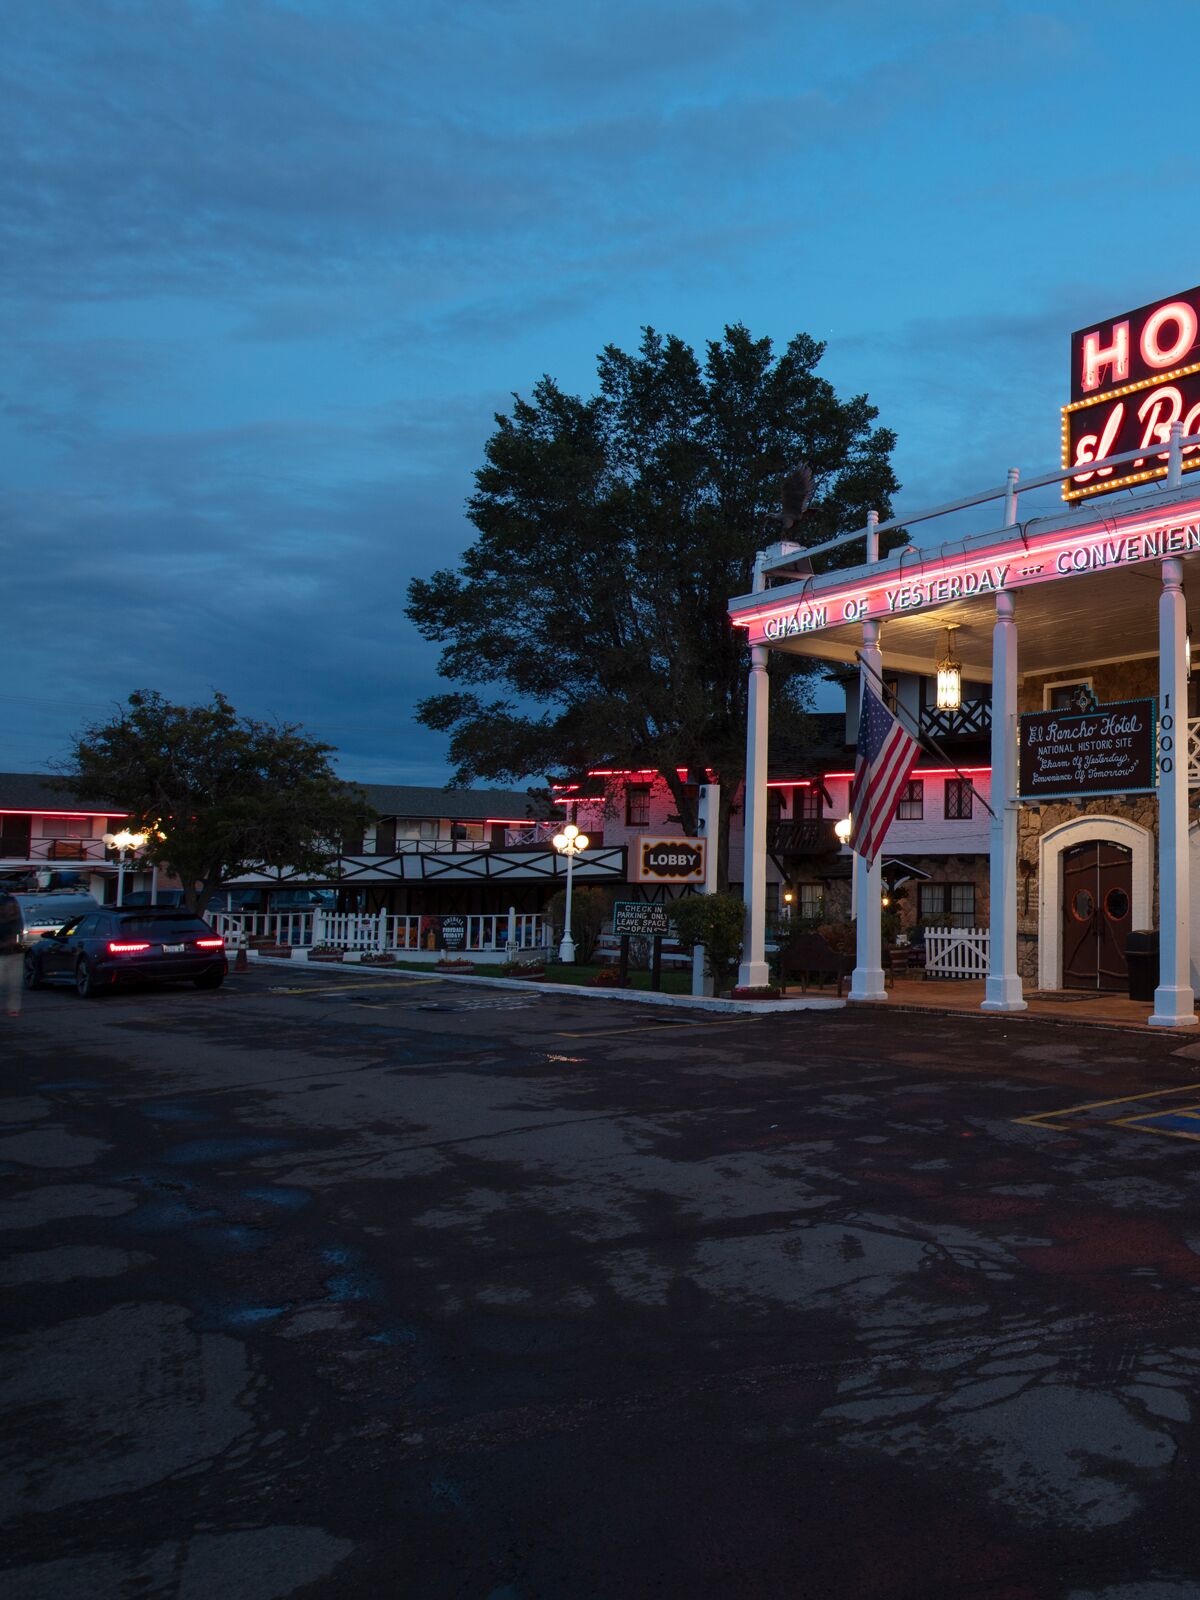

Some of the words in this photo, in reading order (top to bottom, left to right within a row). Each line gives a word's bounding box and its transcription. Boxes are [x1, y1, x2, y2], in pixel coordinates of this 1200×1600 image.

[764, 606, 828, 638] CHARM
[843, 597, 868, 621] OF
[885, 564, 1010, 611] YESTERDAY
[1028, 725, 1043, 747] El
[1046, 720, 1097, 742] Rancho
[1100, 714, 1143, 736] Hotel
[1038, 745, 1074, 755] NATIONAL
[1078, 739, 1113, 751] HISTORIC
[1115, 737, 1133, 748] SITE
[649, 854, 697, 865] LOBBY
[625, 905, 652, 913] CHECK
[617, 911, 647, 919] PARKING
[616, 918, 639, 926] LEAVE
[642, 919, 667, 927] SPACE
